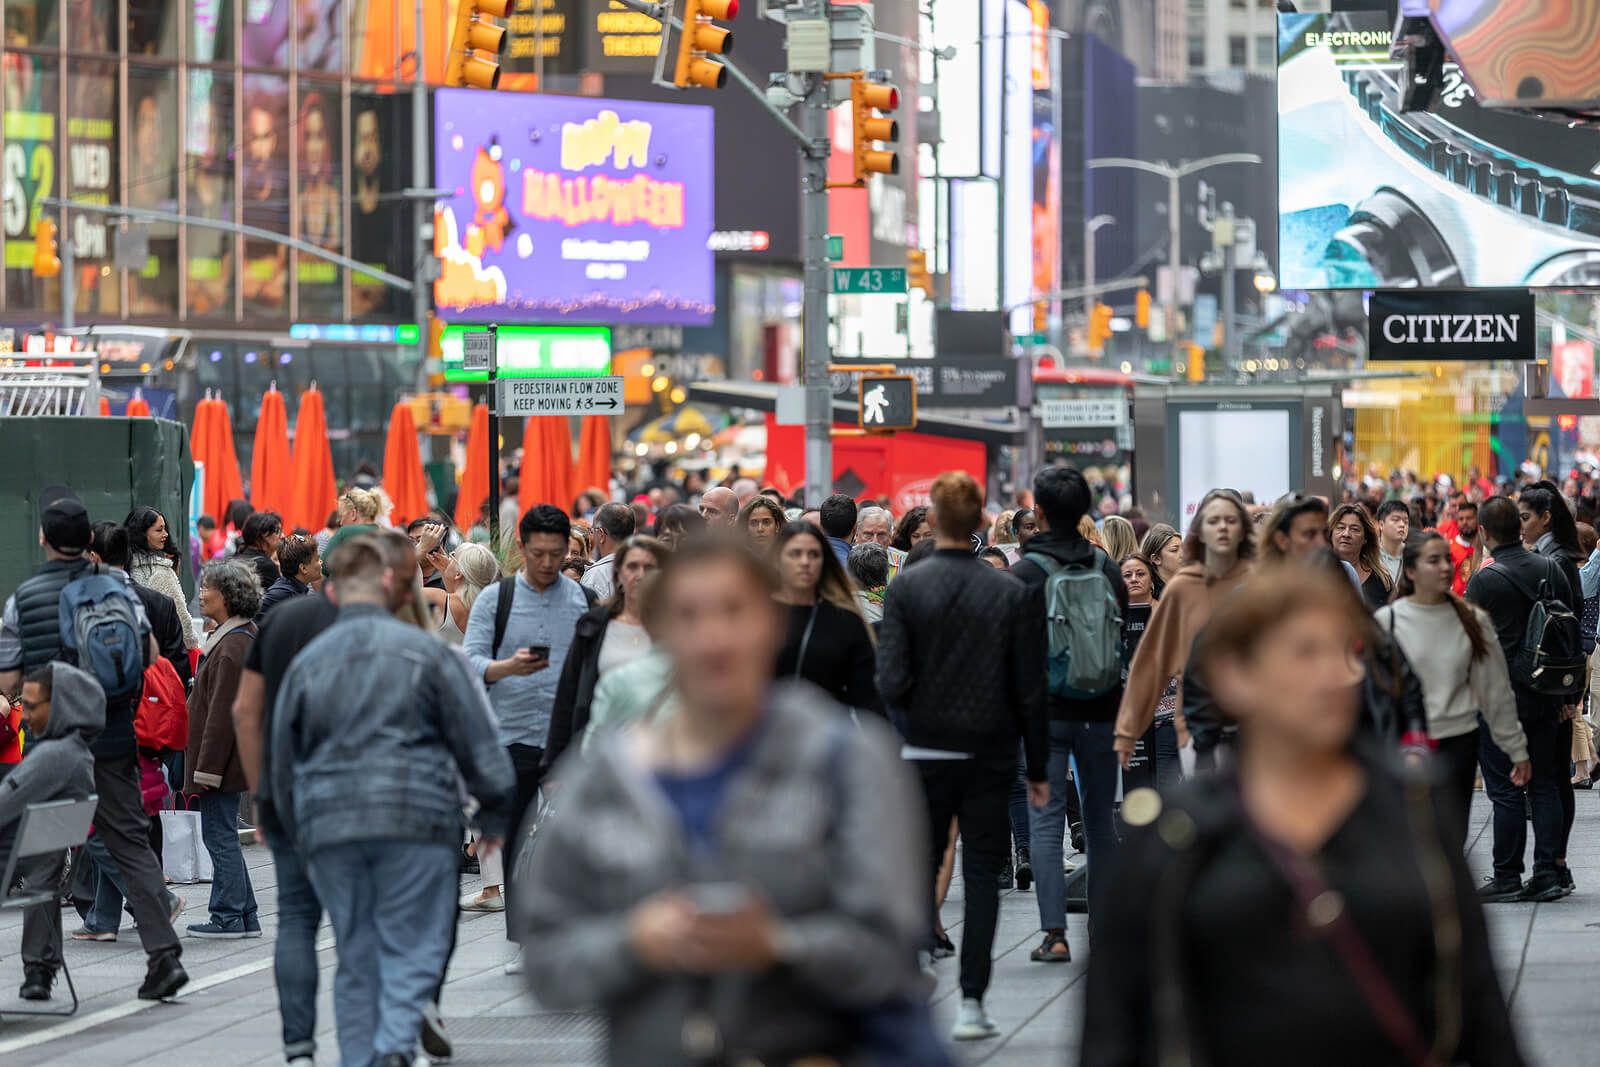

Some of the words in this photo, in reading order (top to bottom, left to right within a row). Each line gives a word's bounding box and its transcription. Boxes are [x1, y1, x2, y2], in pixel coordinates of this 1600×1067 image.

[836, 271, 851, 291] W
[858, 270, 883, 291] 43
[1382, 314, 1521, 344] CITIZEN
[513, 382, 566, 395] PEDESTRIAN
[569, 382, 593, 394] FLOW
[595, 382, 619, 394] ZONE
[513, 398, 535, 410] KEEP
[538, 398, 571, 410] MOVING
